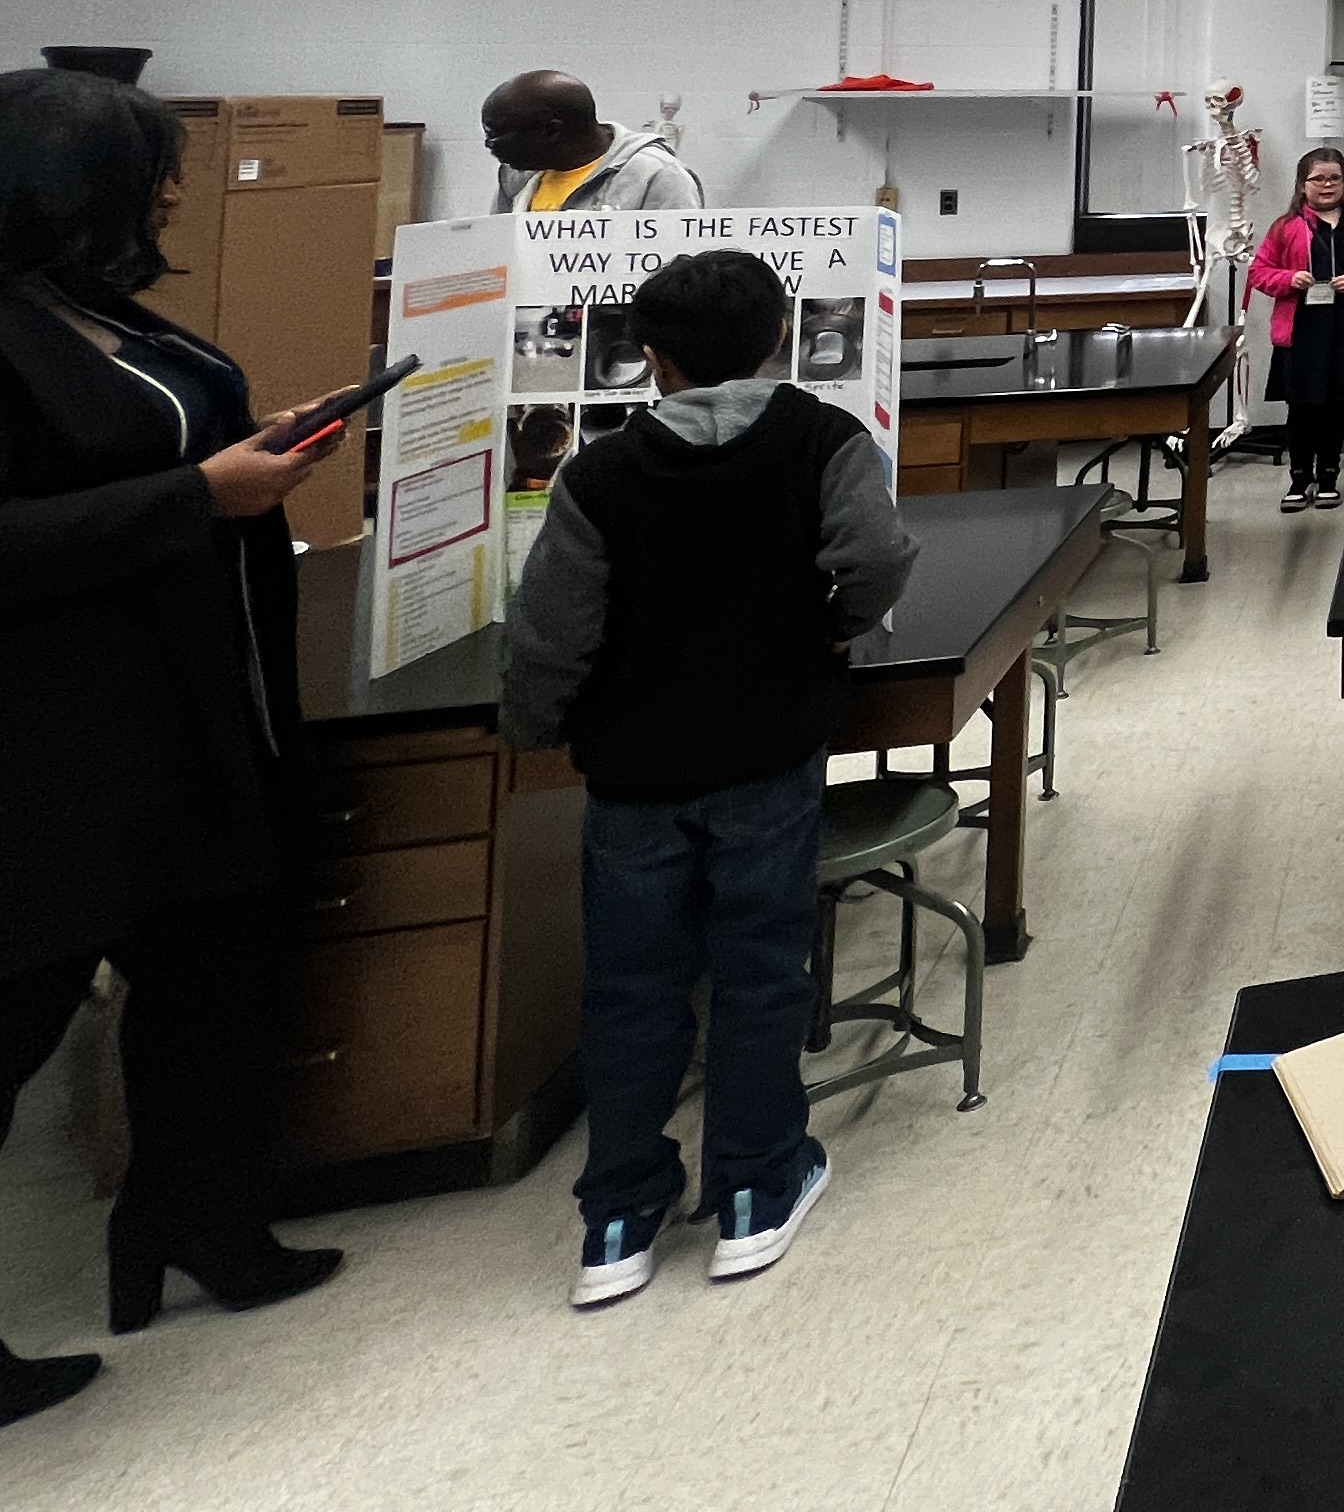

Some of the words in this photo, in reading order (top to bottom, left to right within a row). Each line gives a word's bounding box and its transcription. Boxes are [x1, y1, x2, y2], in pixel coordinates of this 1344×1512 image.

[525, 218, 612, 240] WHAT
[634, 218, 658, 240] IS
[681, 217, 734, 238] THE
[749, 216, 859, 238] FASTEST
[549, 252, 612, 274] WAY
[624, 252, 662, 273] TO
[828, 248, 847, 269] A
